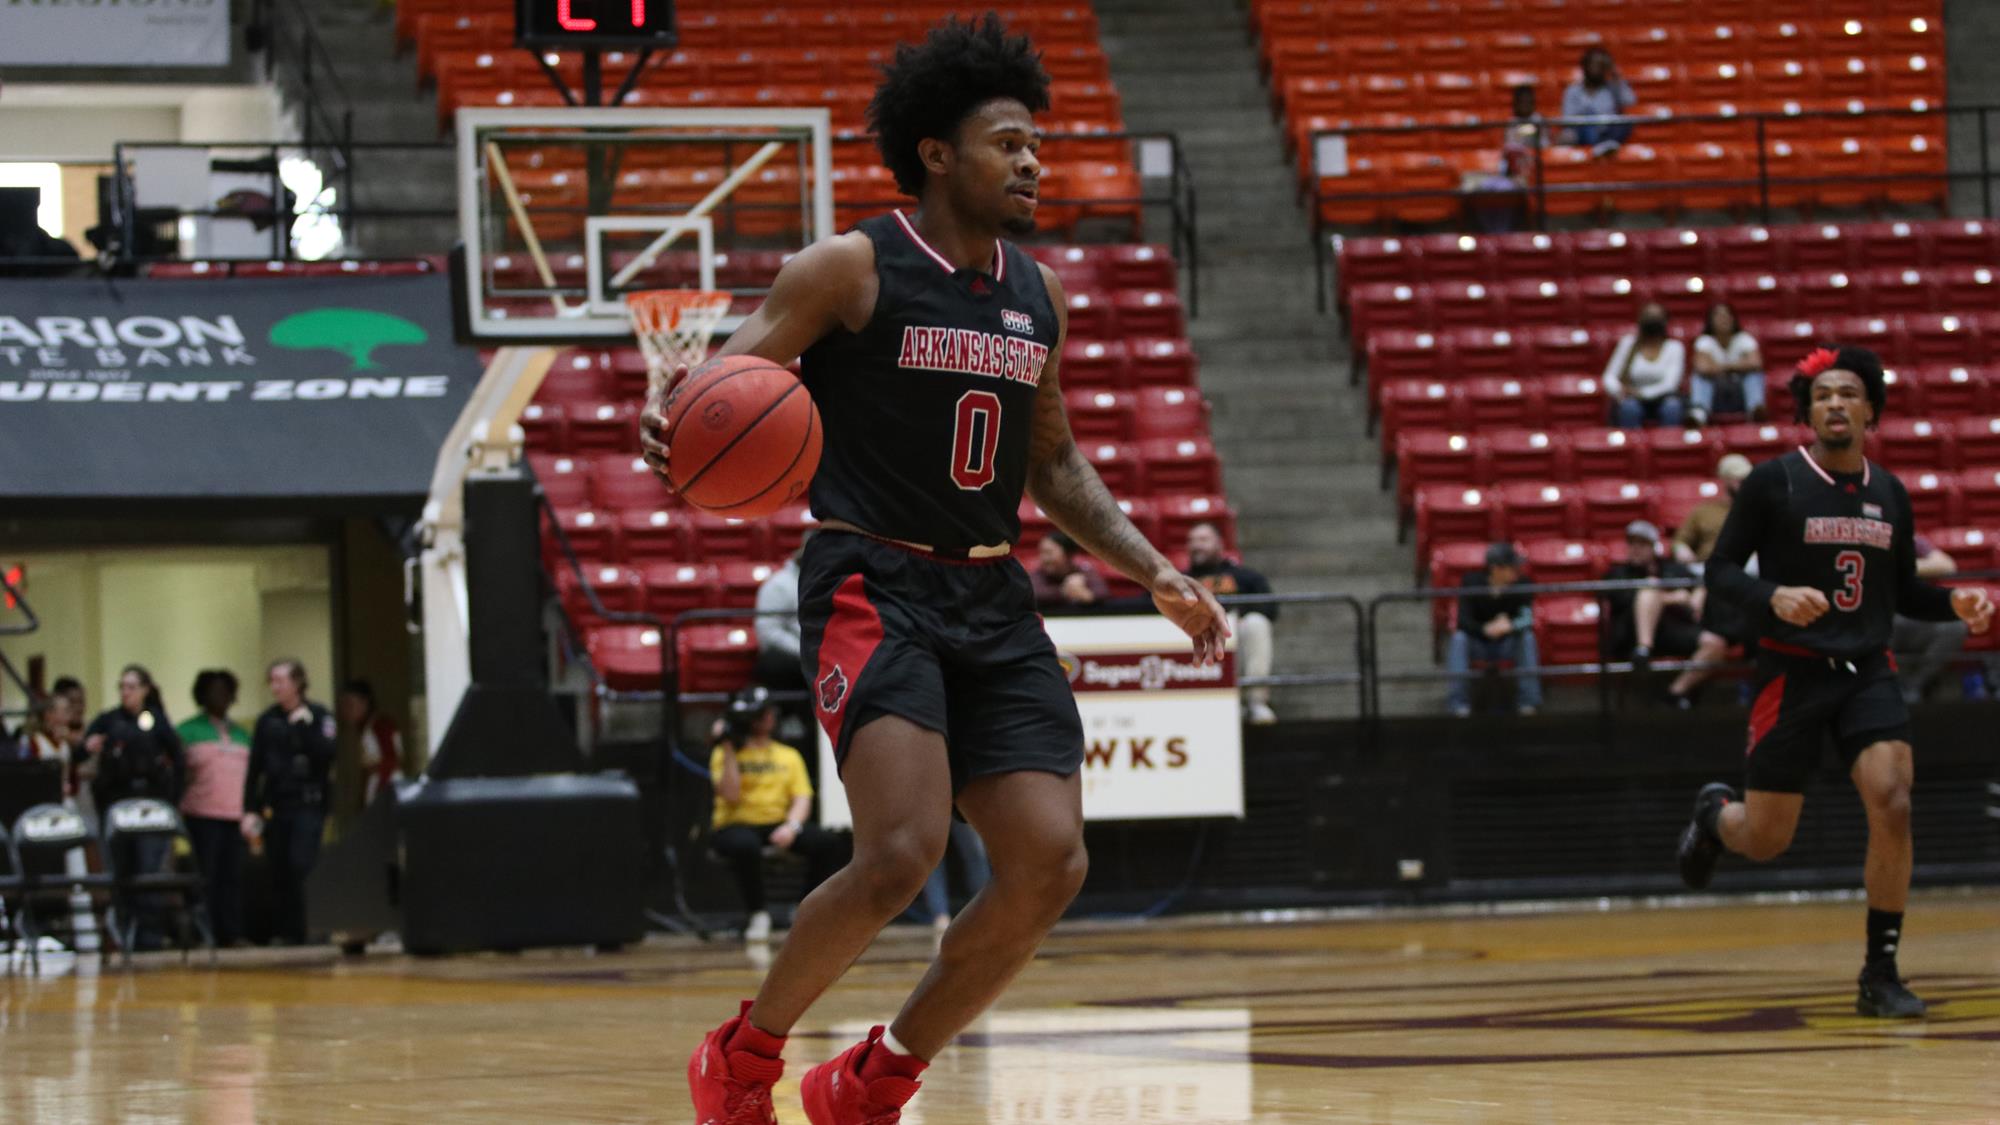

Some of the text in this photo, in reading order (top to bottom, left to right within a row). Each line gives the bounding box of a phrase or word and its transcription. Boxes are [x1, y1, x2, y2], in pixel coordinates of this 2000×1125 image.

[1001, 309, 1034, 335] SBC
[95, 345, 256, 367] BANK
[898, 326, 1048, 388] ARKANSAS STATE
[252, 375, 449, 400] ZONE
[950, 389, 1002, 491] 0
[1834, 550, 1865, 612] 3
